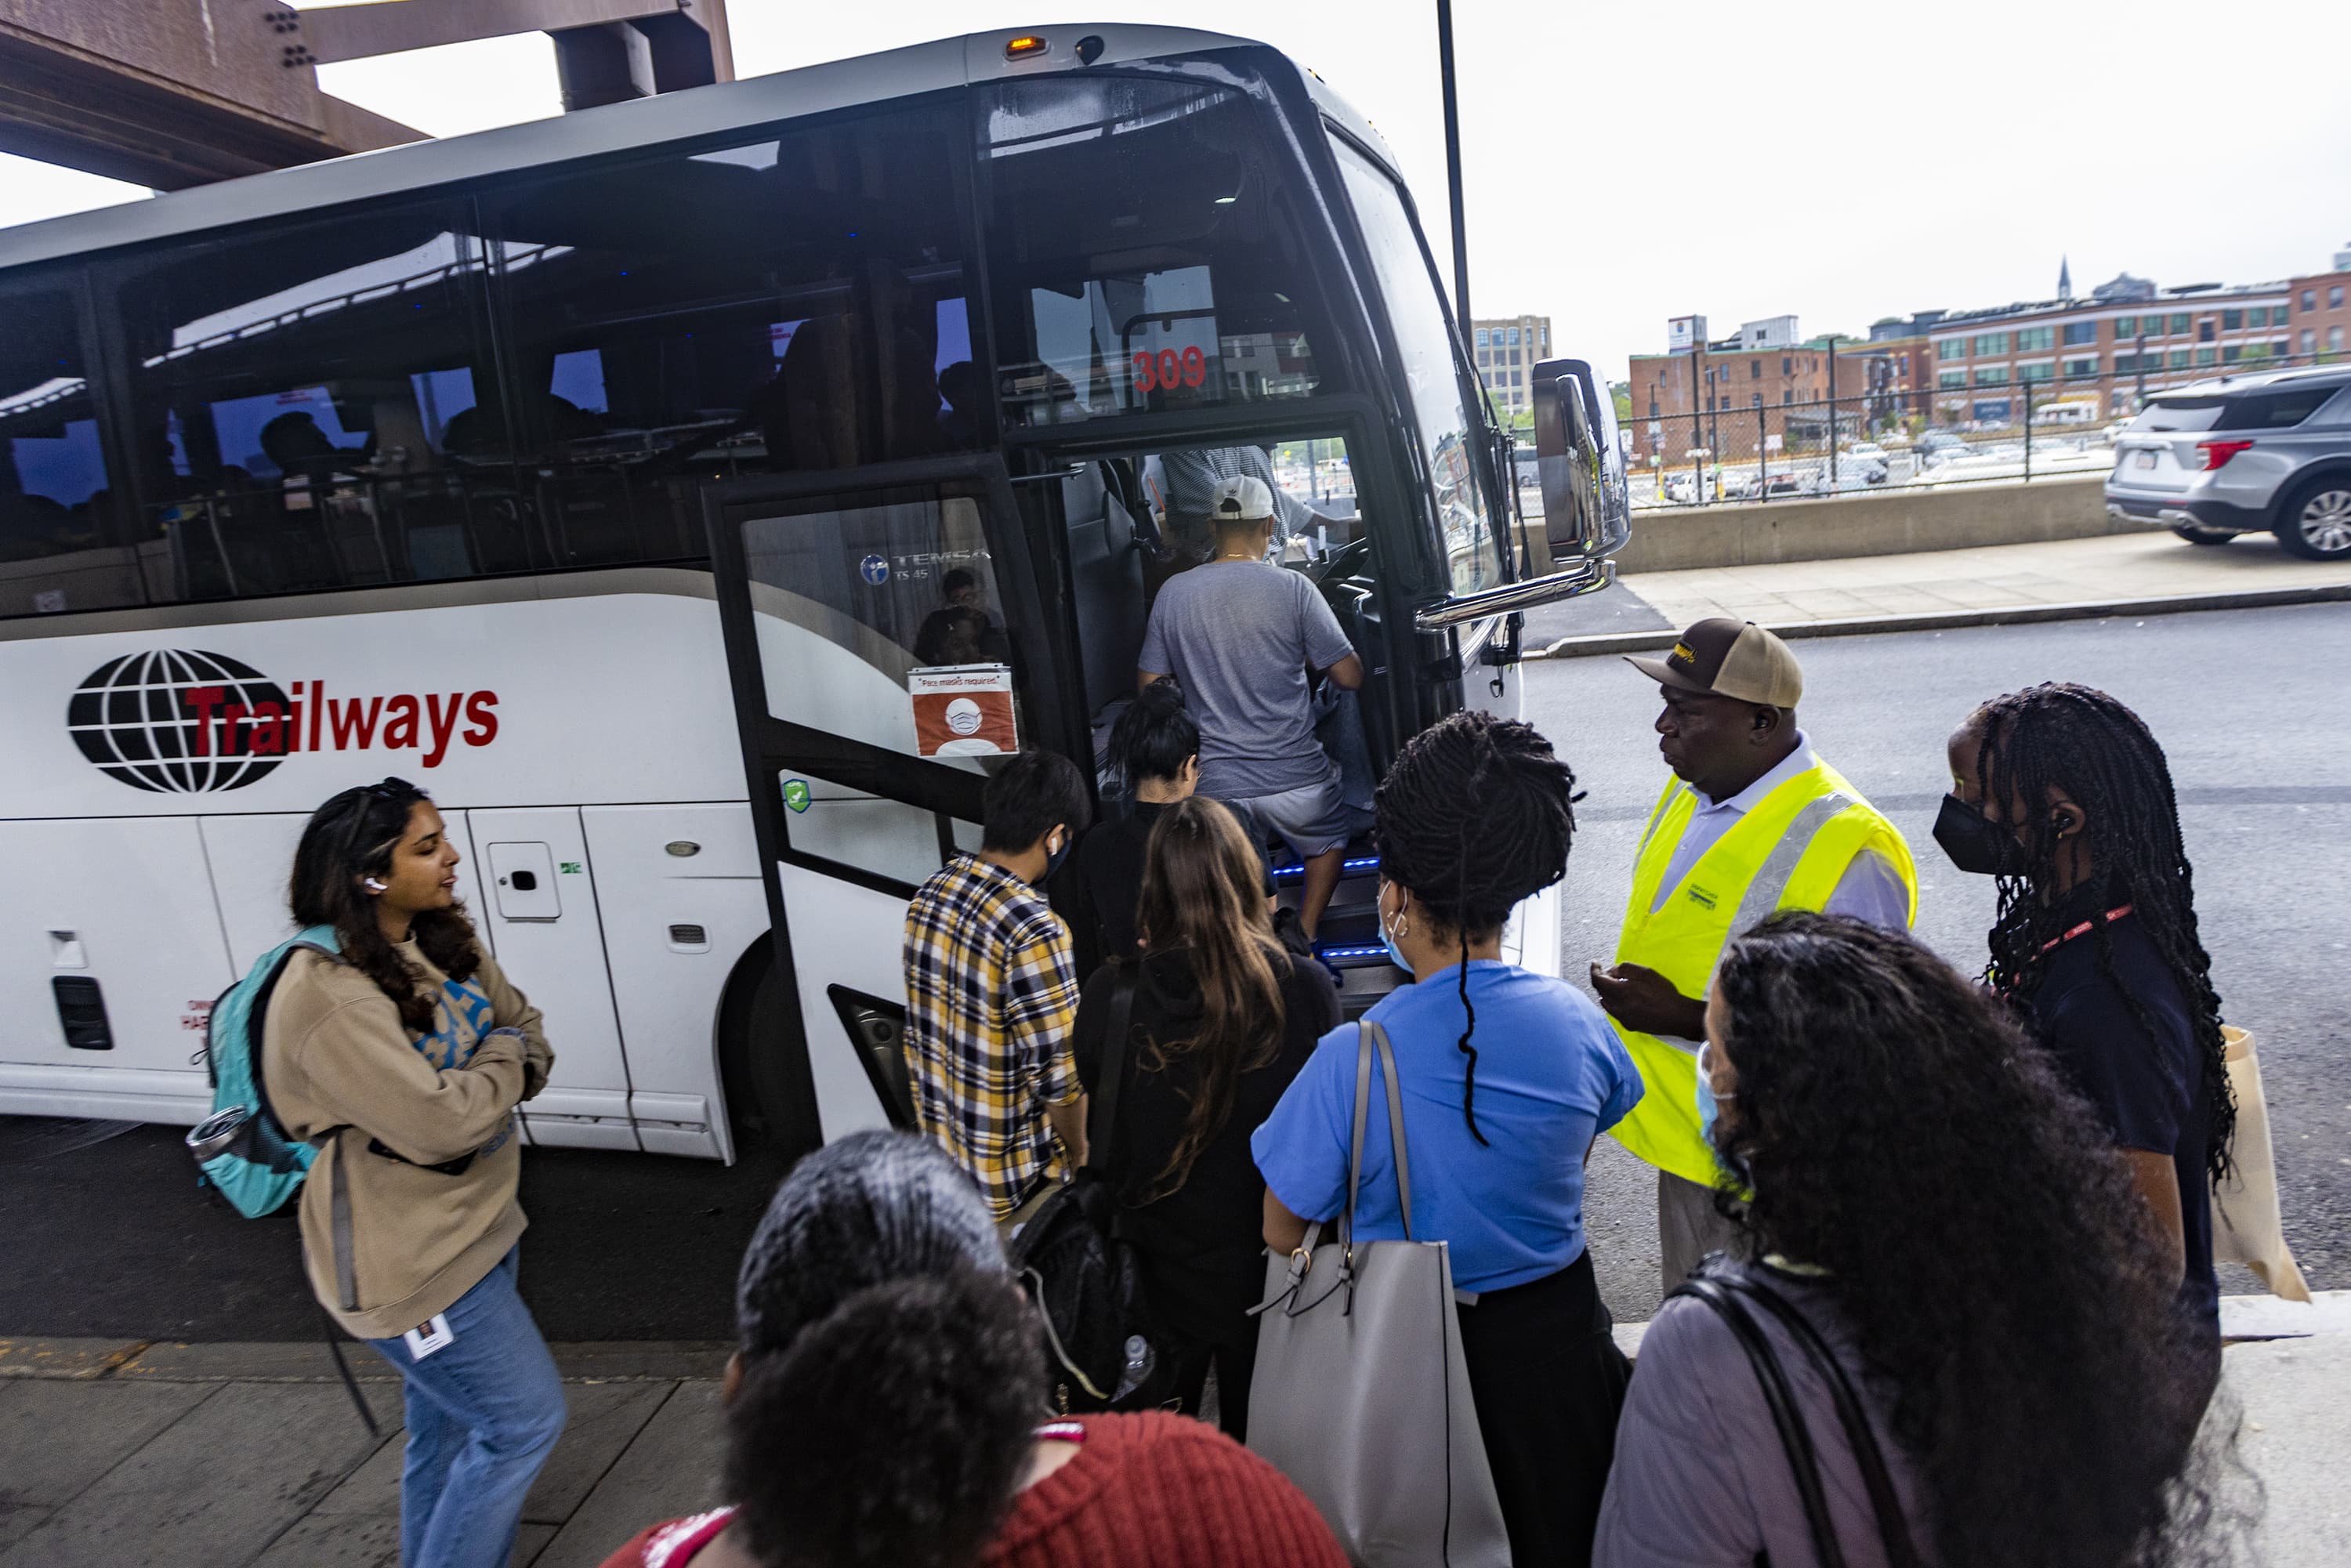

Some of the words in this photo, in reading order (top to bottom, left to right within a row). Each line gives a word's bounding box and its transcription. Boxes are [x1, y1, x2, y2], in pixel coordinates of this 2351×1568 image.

[1132, 345, 1206, 393] 309
[892, 549, 992, 567] TEMSA
[894, 570, 910, 581] TS
[913, 569, 929, 579] 45
[185, 679, 499, 769] Trailways
